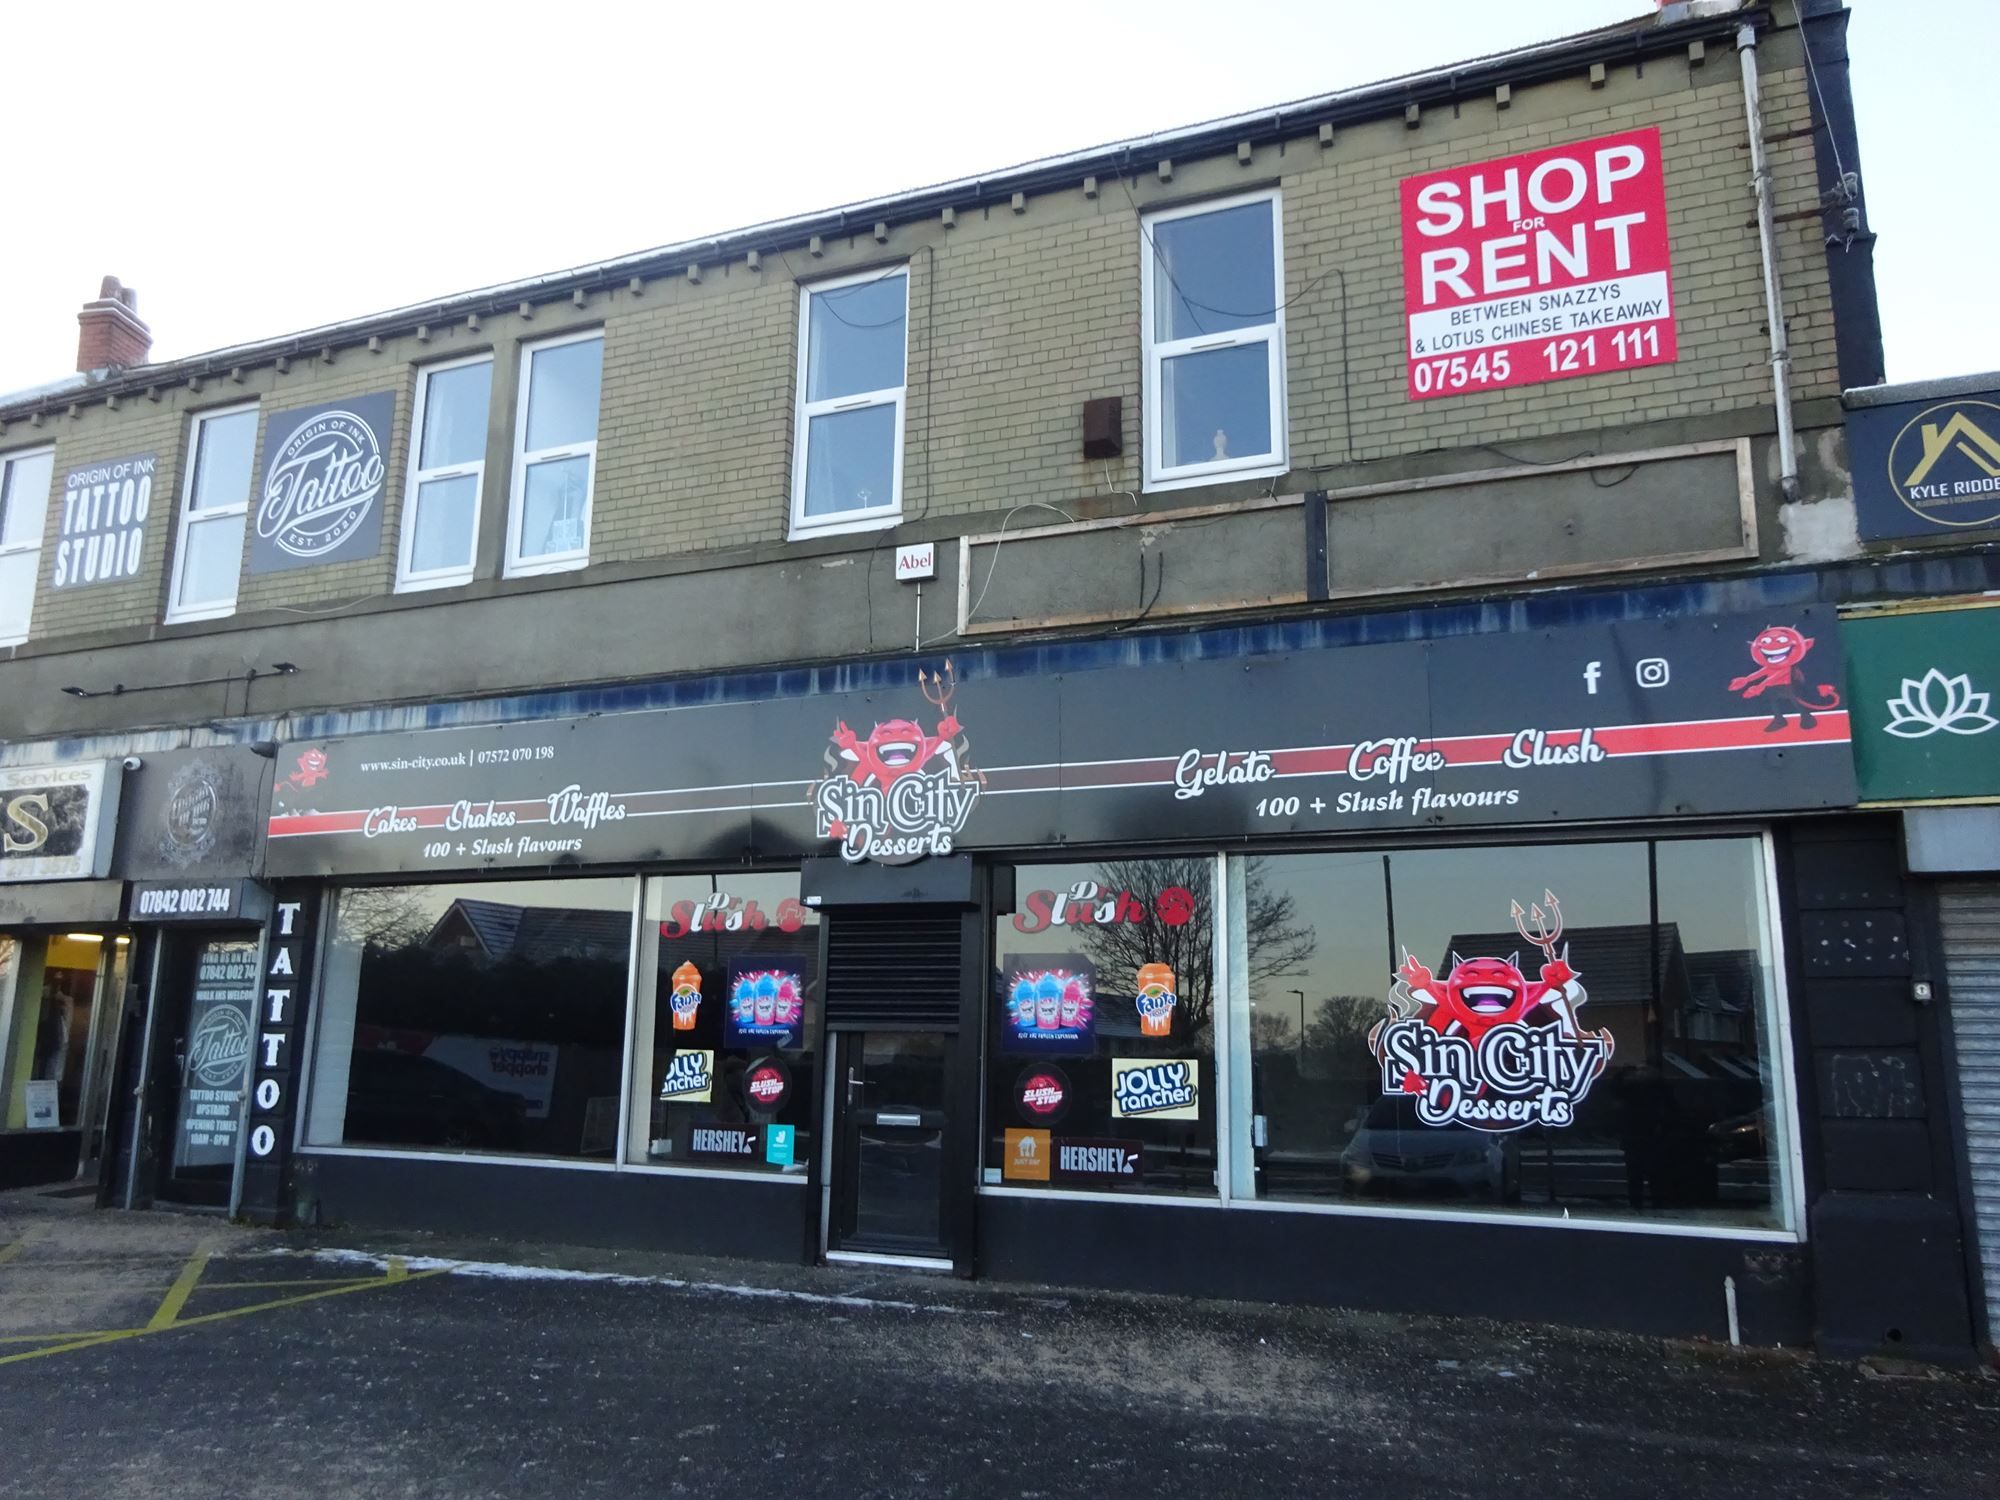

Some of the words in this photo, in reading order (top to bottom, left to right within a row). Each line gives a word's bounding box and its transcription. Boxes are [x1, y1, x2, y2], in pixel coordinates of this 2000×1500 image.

[1416, 144, 1645, 237] SHOP
[1513, 216, 1545, 233] FOR
[1420, 212, 1646, 305] RENT
[1451, 298, 1532, 326] BETWEEN
[1539, 283, 1621, 311] SNAZZYS
[1415, 339, 1425, 353] &
[1432, 328, 1485, 351] LOTUS
[1491, 315, 1563, 341] CHINESE
[1570, 299, 1663, 328] TAKEAWAY
[1414, 350, 1511, 393] 07545
[1543, 335, 1597, 373] 121
[1611, 325, 1659, 362] 111
[287, 422, 327, 457] ORIGIN
[331, 420, 347, 430] OF
[348, 425, 366, 444] INK
[67, 467, 111, 489] ORIGIN
[113, 463, 132, 480] OF
[133, 458, 156, 475] INK
[63, 474, 152, 536] TATTOO
[257, 441, 385, 540] Tattoo
[1910, 483, 1949, 499] KYLE
[289, 533, 317, 548] EST.
[325, 510, 357, 542] 2020
[54, 527, 143, 587] STUDIO
[898, 551, 931, 571] Abel
[360, 752, 466, 772] www.sin-city.co.uk
[477, 749, 509, 764] 07572
[512, 747, 532, 761] 070
[534, 745, 555, 760] 198
[1174, 748, 1276, 800] Gelato
[1348, 737, 1445, 784] Coffee
[1503, 728, 1606, 769] Slush
[6, 768, 92, 787] Services
[363, 805, 417, 838] Cakes
[444, 800, 516, 832] Shakes
[546, 784, 626, 830] Waffles
[820, 777, 884, 831] Sin
[889, 774, 977, 832] City
[1256, 797, 1300, 817] 100
[1310, 797, 1326, 814] +
[1336, 791, 1403, 813] Slush
[1412, 788, 1519, 815] flavours
[0, 793, 49, 852] S
[423, 841, 450, 859] 100
[456, 843, 467, 855] +
[471, 837, 513, 856] Slush
[517, 835, 582, 858] flavours
[841, 822, 952, 861] Desserts
[140, 889, 178, 914] 07842
[180, 889, 205, 912] 002
[207, 888, 231, 912] 744
[707, 892, 742, 910] Dr
[1069, 880, 1112, 901] Dr
[660, 899, 770, 938] Slush
[1012, 889, 1149, 934] Slush
[200, 965, 226, 980] 07842
[226, 964, 244, 980] 002
[671, 991, 702, 1011] Fanta
[1136, 991, 1177, 1016] Fanta
[251, 902, 301, 1156] TATTOO
[1387, 1025, 1476, 1089] Sin
[1484, 1026, 1597, 1092] City
[190, 1089, 215, 1101] TATTOO
[751, 1079, 778, 1089] SLUSH
[760, 1084, 784, 1096] STOP
[1024, 1087, 1055, 1097] SLUSH
[1116, 1063, 1185, 1098] JOLLY
[196, 1103, 230, 1116] UPSTAIRS
[1036, 1094, 1062, 1105] STOP
[1121, 1086, 1191, 1111] rancher
[1418, 1079, 1571, 1123] Desserts
[186, 1119, 215, 1131] OPENING
[216, 1120, 238, 1132] TIMES
[693, 1129, 746, 1153] HERSHEY
[1060, 1146, 1125, 1173] HERSHEY
